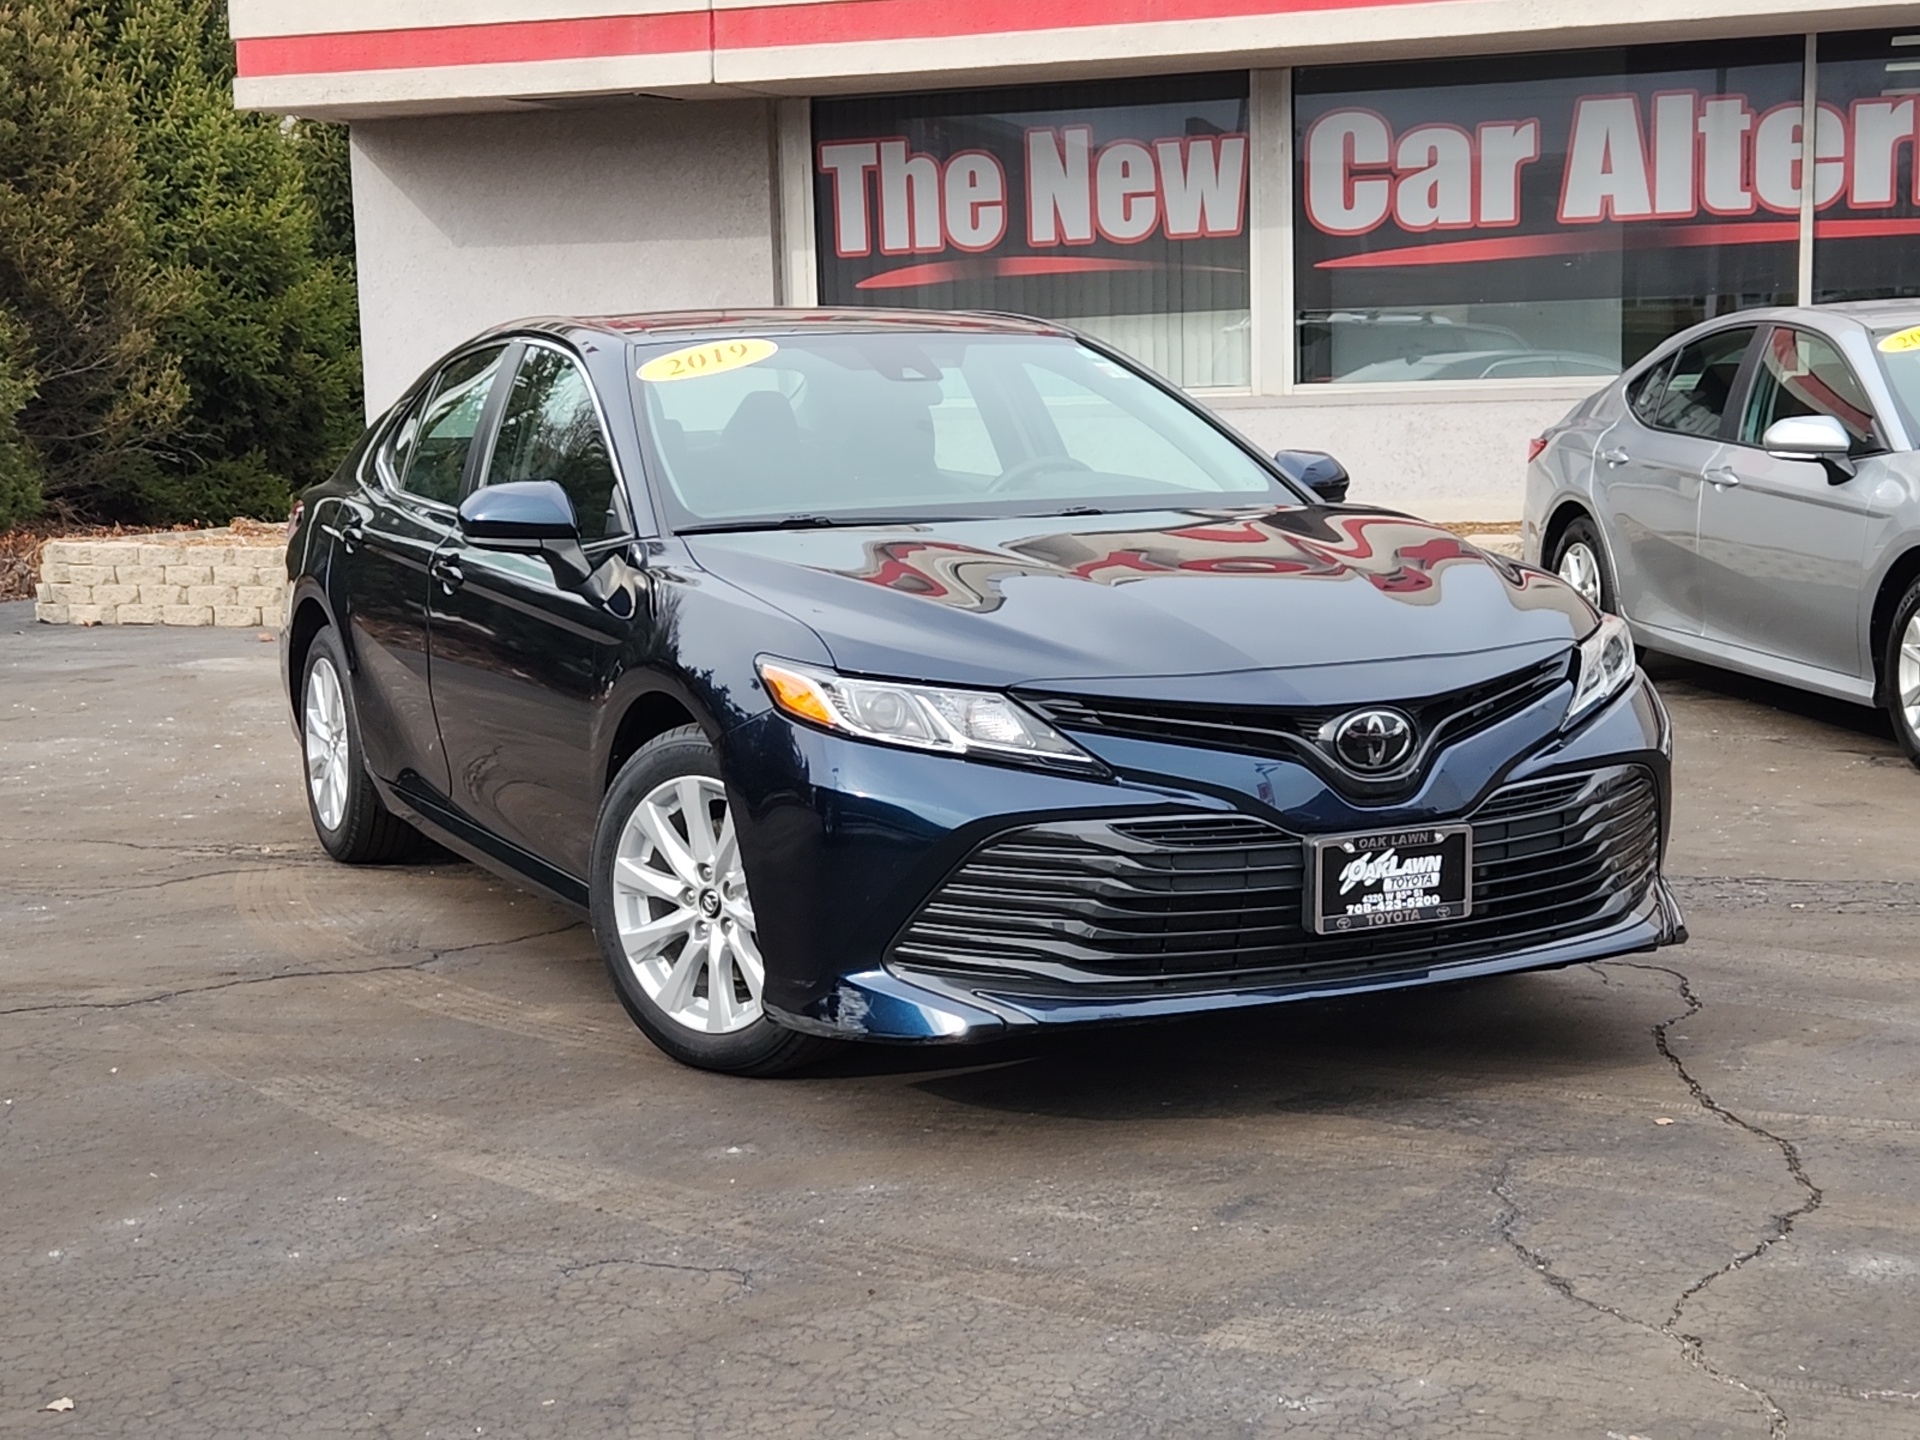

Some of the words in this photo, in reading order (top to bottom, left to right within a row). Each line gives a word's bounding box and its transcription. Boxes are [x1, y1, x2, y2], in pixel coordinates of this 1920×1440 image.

[818, 137, 1007, 258] The
[1024, 123, 1249, 246] New
[1304, 106, 1540, 235] Car
[1556, 88, 1920, 223] Alter
[666, 343, 748, 376] 2019
[1359, 836, 1387, 849] OAK
[1391, 831, 1429, 846] LAWN
[1390, 874, 1433, 889] TOYOTA
[1366, 909, 1421, 926] TOYOTA
